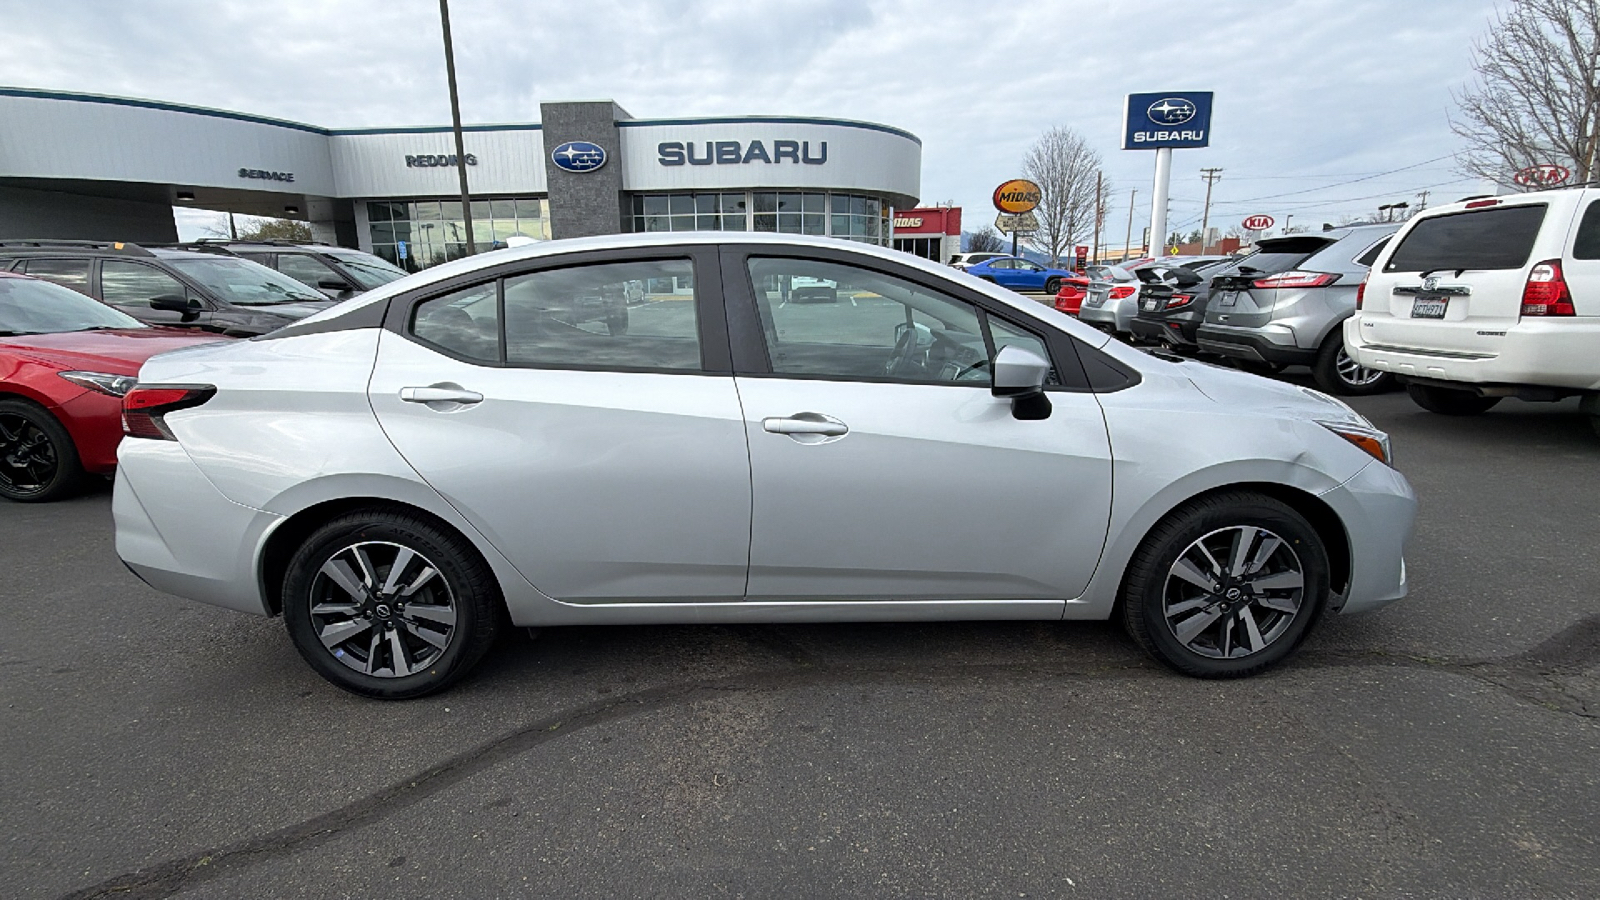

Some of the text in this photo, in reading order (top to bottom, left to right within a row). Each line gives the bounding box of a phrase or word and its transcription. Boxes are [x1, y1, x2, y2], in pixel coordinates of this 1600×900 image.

[1133, 130, 1204, 143] SUBARU
[657, 139, 828, 167] SUBARU
[237, 167, 295, 183] SERVICE
[1000, 190, 1039, 203] MIDAS
[1249, 217, 1269, 228] KIA
